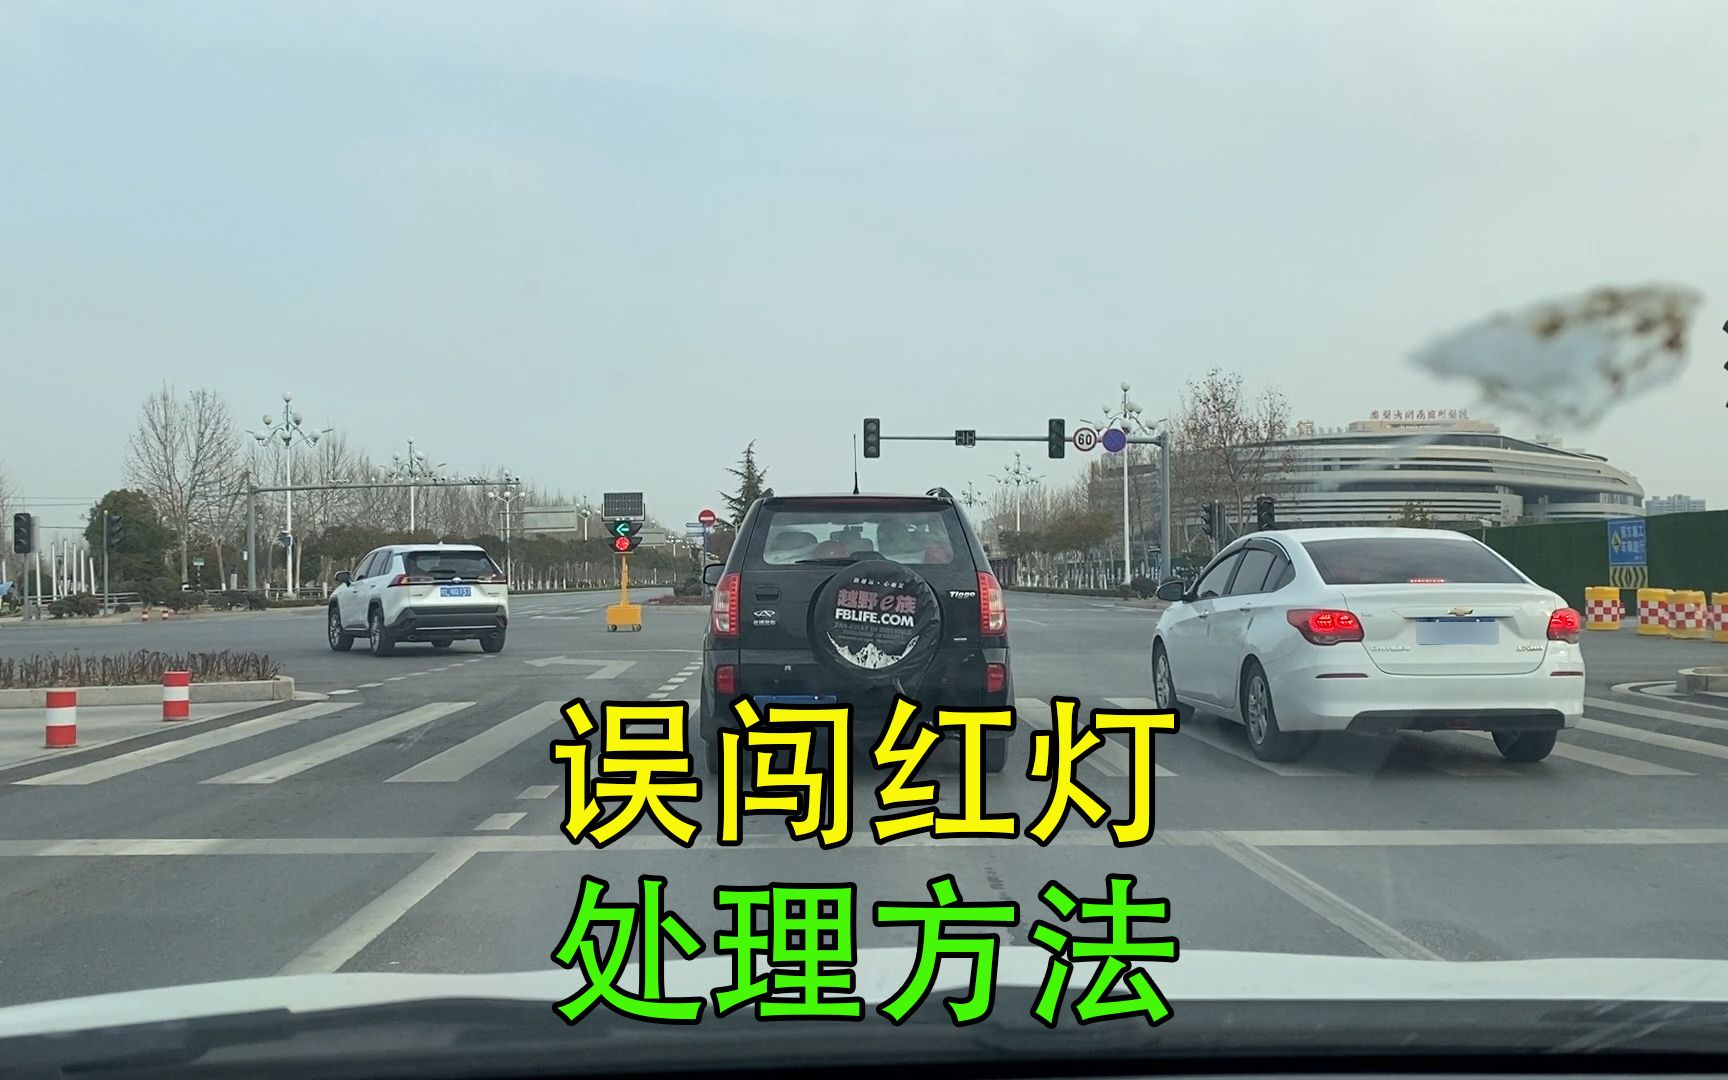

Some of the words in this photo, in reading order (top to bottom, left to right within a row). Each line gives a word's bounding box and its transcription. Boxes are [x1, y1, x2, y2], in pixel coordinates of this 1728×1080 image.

[1078, 433, 1092, 446] 60
[949, 591, 976, 599] Tiggo
[835, 608, 915, 628] FBLIFE.COM
